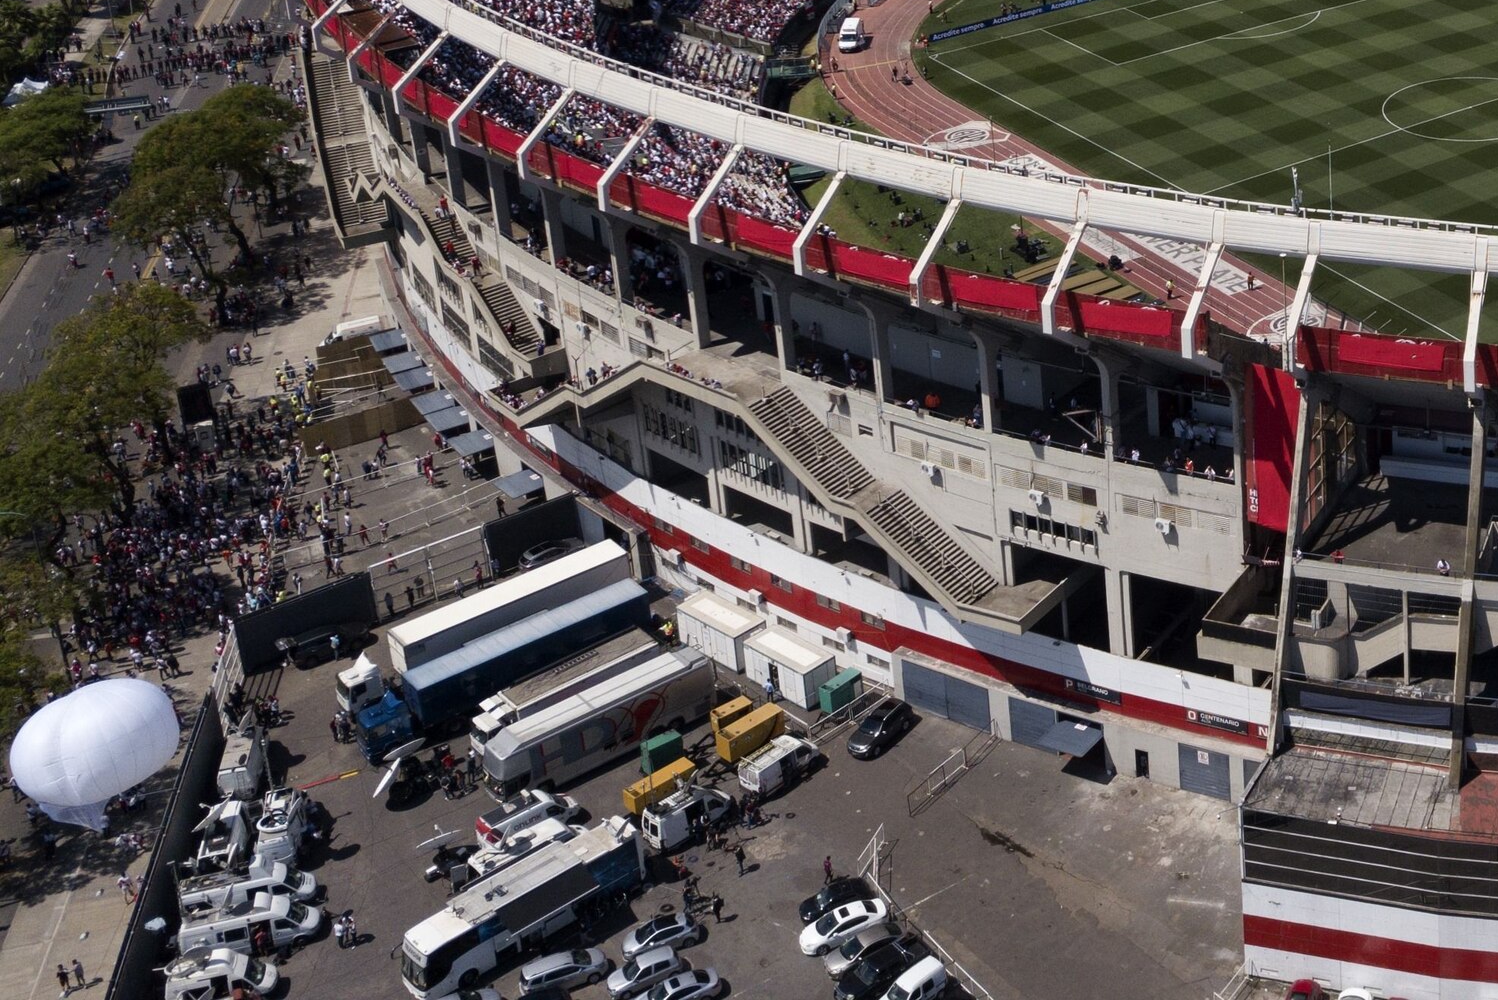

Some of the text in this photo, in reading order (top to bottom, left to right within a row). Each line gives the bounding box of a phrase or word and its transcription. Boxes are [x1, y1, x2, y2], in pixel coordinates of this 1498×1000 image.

[1051, 0, 1077, 10] Acredite
[992, 12, 1019, 25] Acredite
[933, 28, 959, 41] Acredite
[1065, 679, 1073, 690] P
[1077, 682, 1109, 696] BELGRANO
[1187, 710, 1196, 721] O
[1200, 713, 1240, 728] CENTENARIO
[1258, 726, 1268, 737] N
